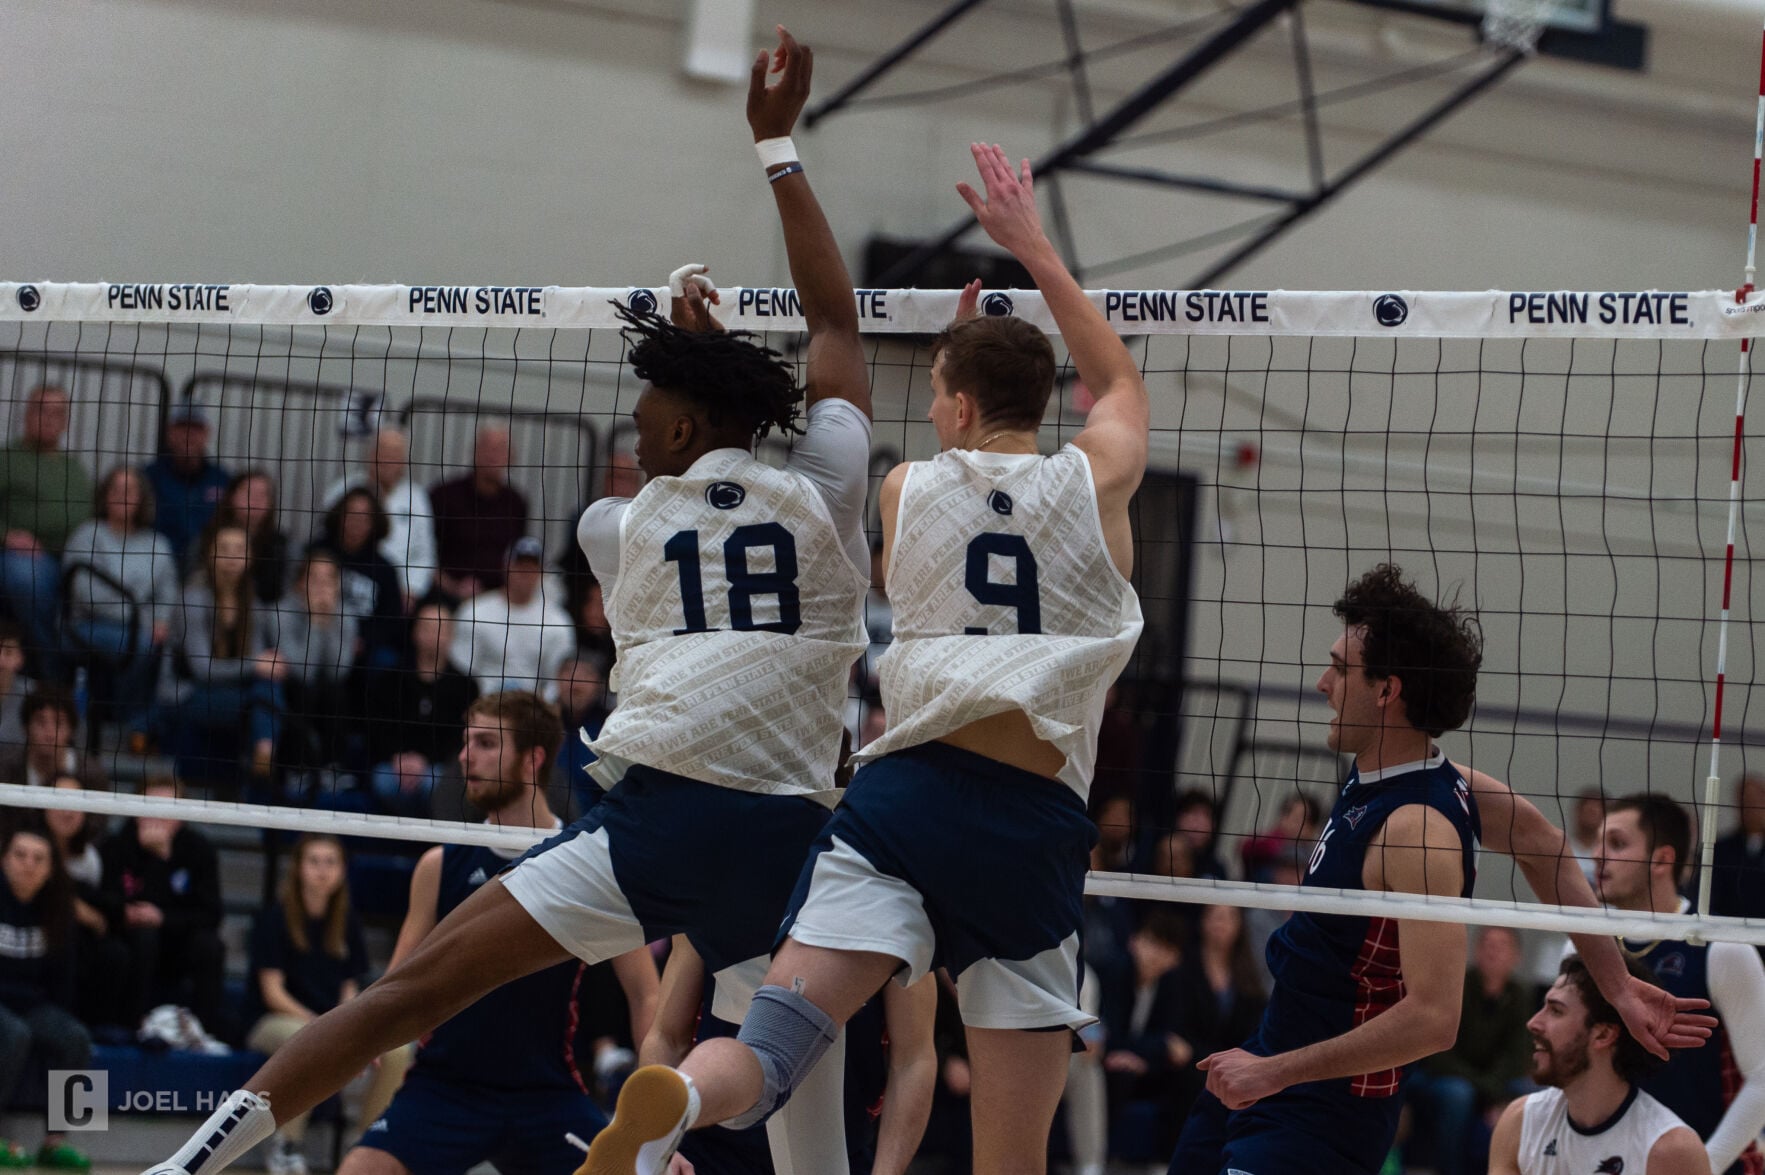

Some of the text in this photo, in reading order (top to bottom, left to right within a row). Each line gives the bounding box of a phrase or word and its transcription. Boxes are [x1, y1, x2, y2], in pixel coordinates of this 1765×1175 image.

[109, 286, 229, 310] PENN STATE
[410, 288, 542, 315] PENN STATE
[739, 288, 805, 317] PENN
[1105, 292, 1268, 322] PENN STATE
[1510, 294, 1688, 324] PENN STATE
[915, 511, 939, 538] PENN
[939, 486, 978, 511] STATE
[638, 516, 664, 543] PENN
[913, 564, 931, 587] ARE
[931, 535, 961, 563] PENN
[642, 565, 663, 594] ARE
[664, 522, 804, 635] 18
[965, 532, 1043, 635] 9
[915, 606, 932, 629] WE
[930, 584, 952, 611] ARE
[772, 637, 796, 652] WE
[971, 656, 1005, 679] PENN
[1005, 638, 1040, 657] STATE
[660, 635, 759, 690] ARE PENN STATE
[806, 655, 830, 672] ARE
[1021, 658, 1058, 677] STATE
[1062, 665, 1081, 679] WE
[677, 692, 705, 716] ARE
[738, 662, 775, 685] STATE
[663, 732, 689, 751] WE
[690, 718, 719, 738] ARE
[750, 688, 785, 710] STATE
